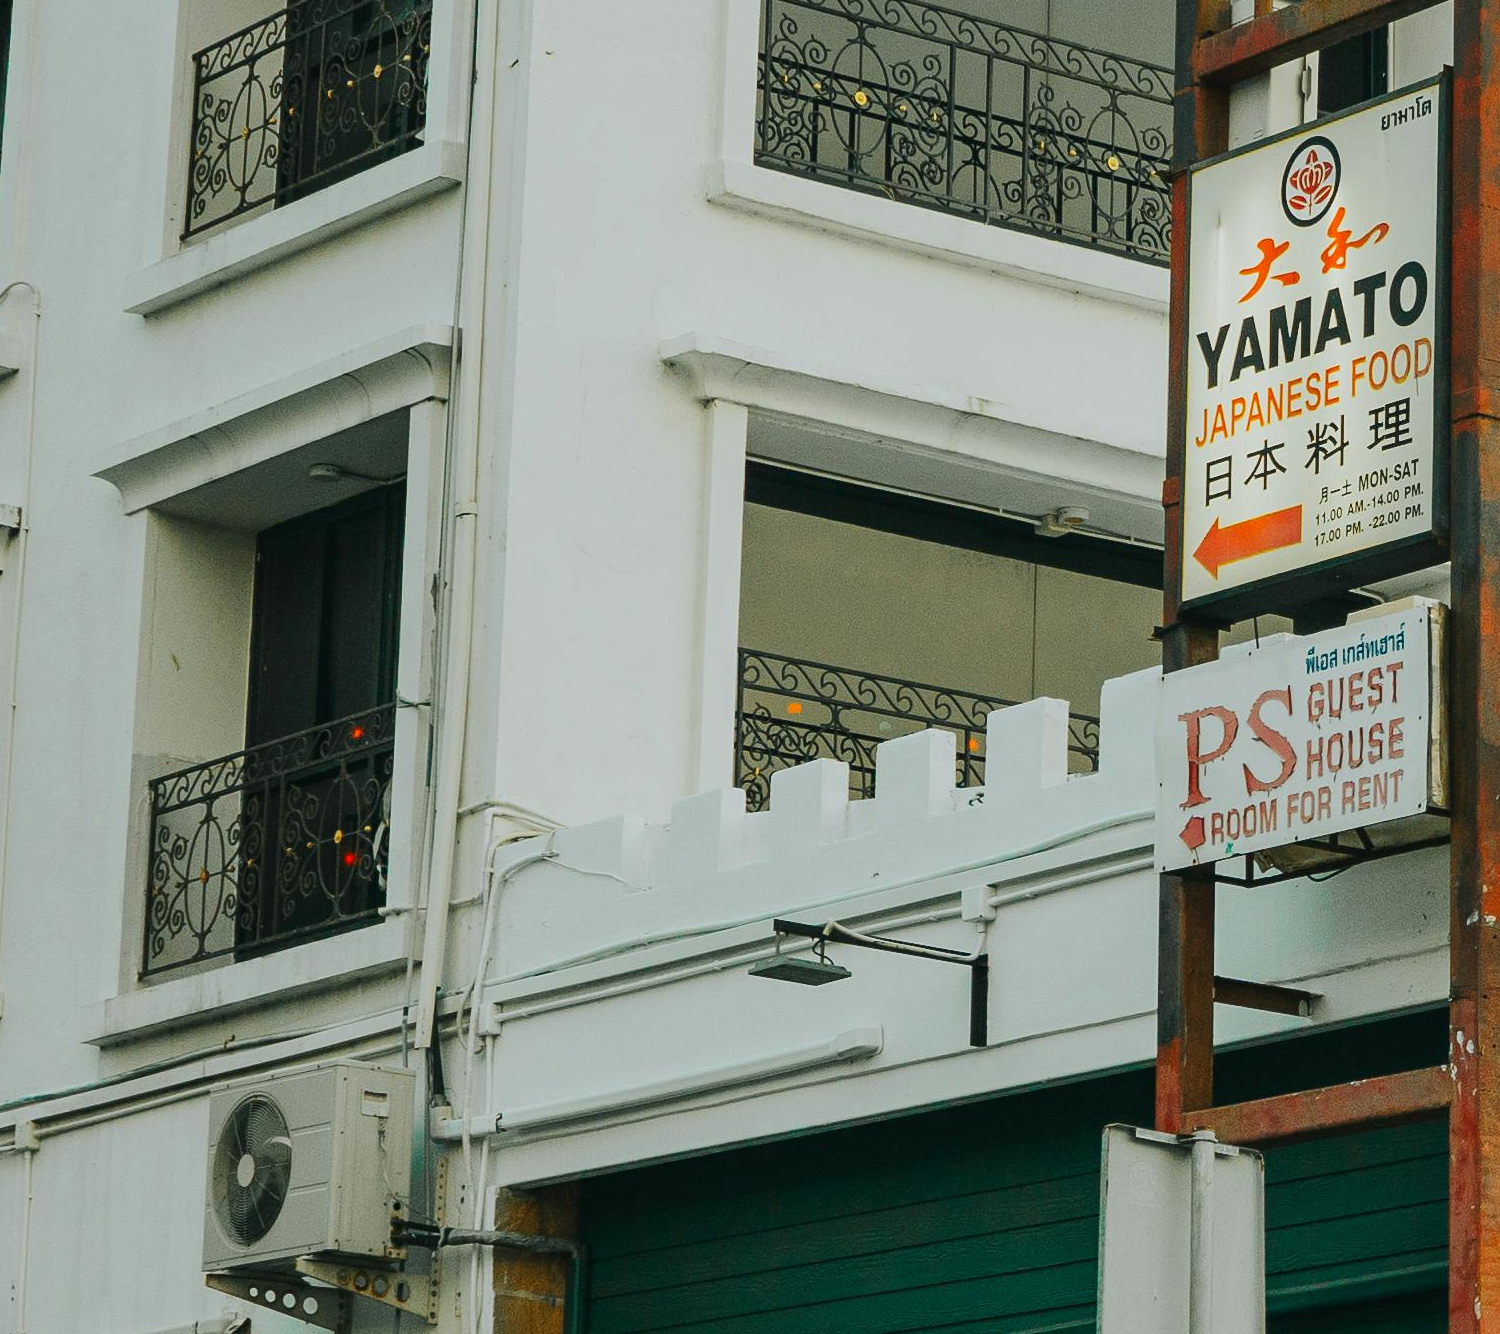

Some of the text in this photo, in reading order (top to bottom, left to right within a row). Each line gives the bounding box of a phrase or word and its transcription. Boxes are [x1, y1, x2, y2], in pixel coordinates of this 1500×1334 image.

[1197, 261, 1428, 390] YAMATO
[1195, 338, 1432, 448] JAPANESE FOOD
[1316, 508, 1343, 526] 11.00
[1404, 483, 1424, 499] PM.
[1359, 459, 1419, 492] MON-SAT
[1314, 530, 1341, 547] 17.00
[1345, 521, 1364, 537] PM.
[1404, 504, 1424, 520] PM.
[1307, 661, 1404, 724] GUEST
[1178, 685, 1297, 810] PS
[1306, 717, 1405, 780] HOUSE
[1211, 769, 1404, 845] ROOM FOR RENT
